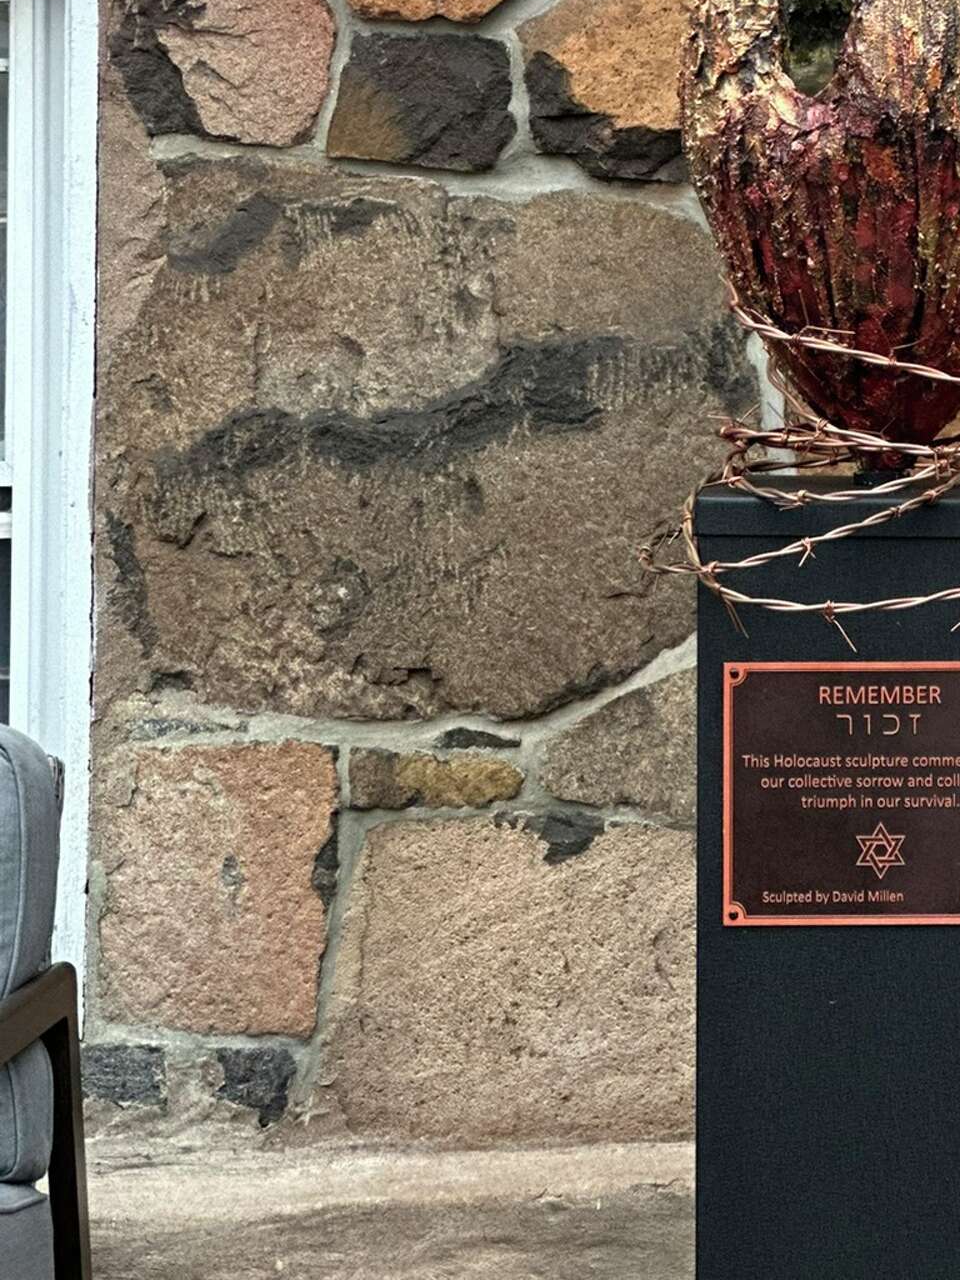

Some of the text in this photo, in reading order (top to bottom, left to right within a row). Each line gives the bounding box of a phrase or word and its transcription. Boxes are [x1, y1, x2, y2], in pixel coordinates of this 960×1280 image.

[820, 686, 941, 704] REMEMBER
[837, 714, 920, 734] זכור
[742, 754, 769, 767] This
[774, 754, 841, 767] Holocaust
[846, 754, 908, 769] sculpture
[761, 778, 784, 788] our
[788, 775, 852, 788] collective
[857, 777, 903, 787] sorrow
[908, 774, 932, 787] and
[801, 794, 959, 810] triumph in our survival.
[763, 890, 903, 904] Sculpted by David Millen
